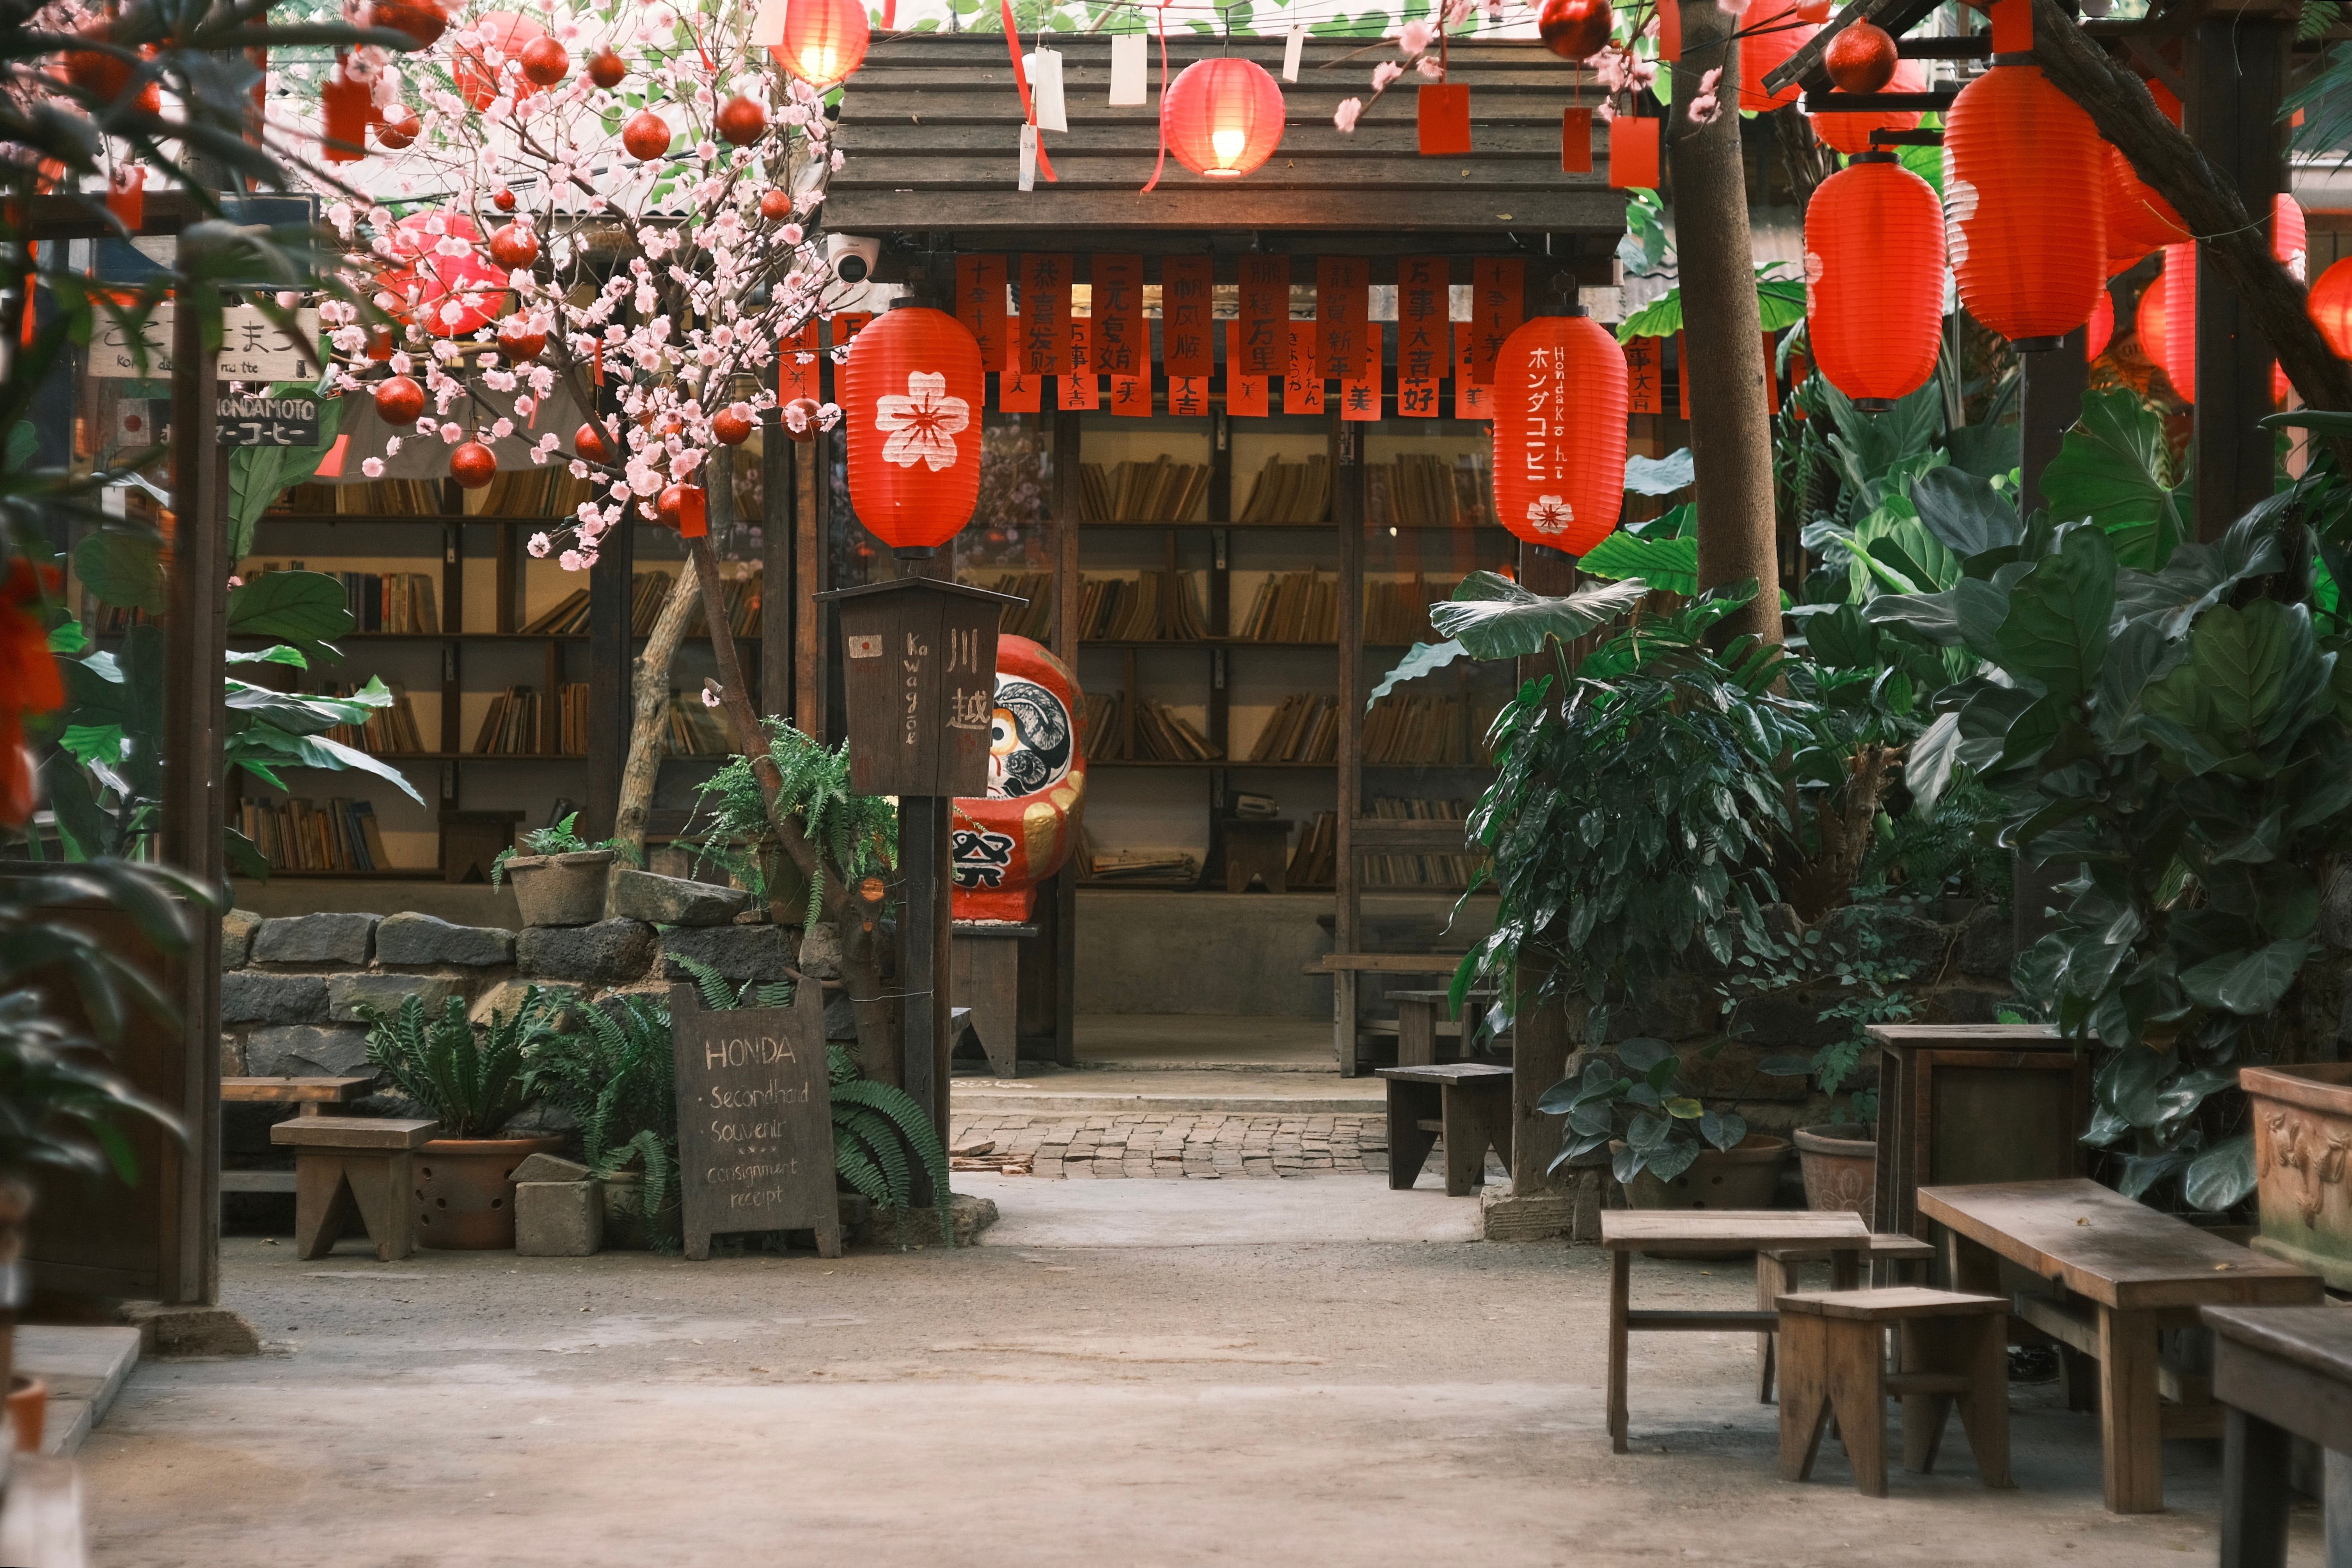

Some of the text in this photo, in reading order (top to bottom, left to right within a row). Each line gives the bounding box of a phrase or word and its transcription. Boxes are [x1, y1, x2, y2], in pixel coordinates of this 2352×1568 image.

[1028, 259, 1058, 374] 恭喜发财
[1097, 266, 1132, 369] 一元复始
[1172, 263, 1205, 359] 一帆风顺
[1248, 262, 1280, 370] 鹏程万里
[1408, 262, 1436, 377] 万事大吉
[1526, 347, 1550, 480] ホンダコーヒー
[945, 629, 990, 729] 川越
[705, 1035, 795, 1070] HONDA
[710, 1079, 808, 1108] Secondhand
[710, 1119, 786, 1142] Souvenir
[731, 1185, 783, 1211] receipt
